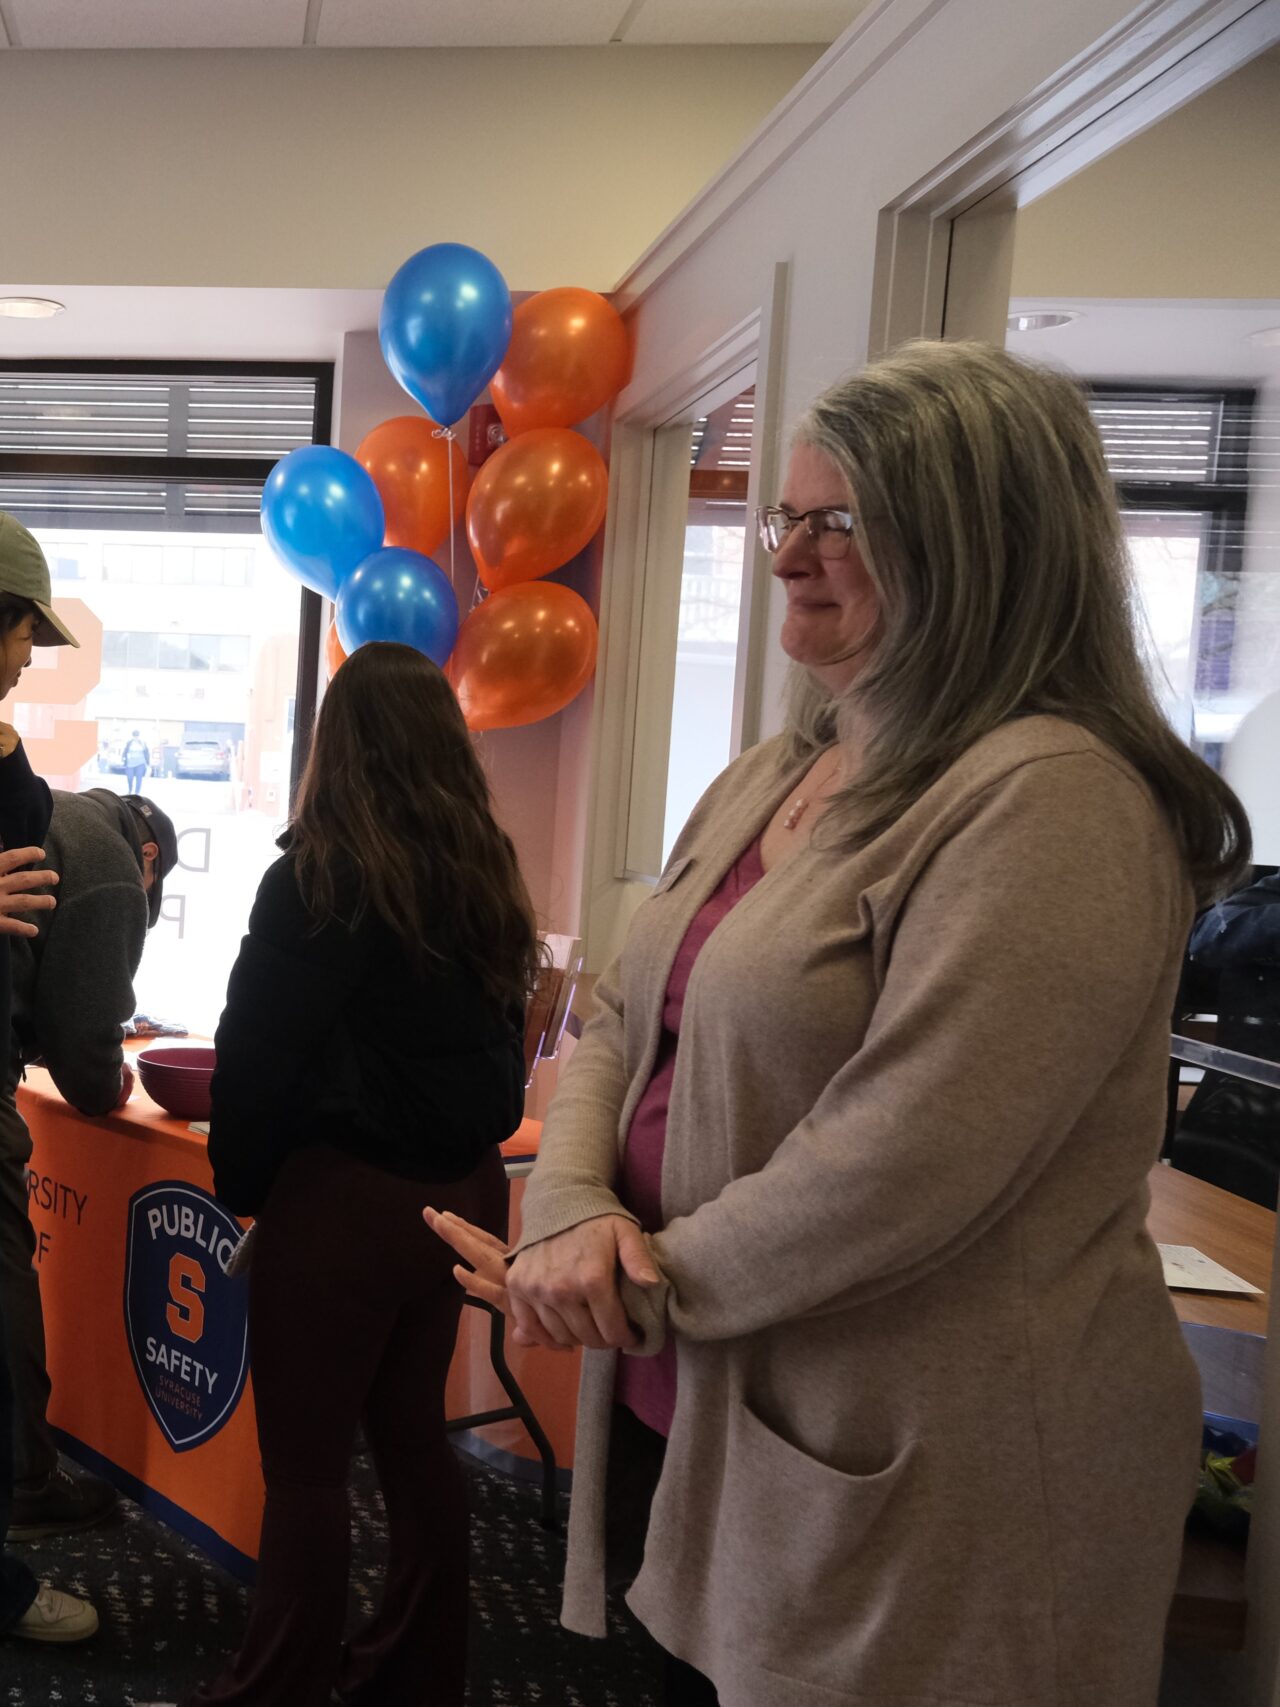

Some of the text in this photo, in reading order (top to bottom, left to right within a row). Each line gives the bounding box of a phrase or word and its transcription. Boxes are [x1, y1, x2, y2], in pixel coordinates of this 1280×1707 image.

[28, 1169, 88, 1226] RSITY
[147, 1204, 236, 1277] PUBLIC
[166, 1252, 206, 1343] S
[145, 1336, 218, 1395] SAFETY
[159, 1375, 201, 1407] SYRACUSE
[155, 1384, 204, 1421] UNIVERSITY
